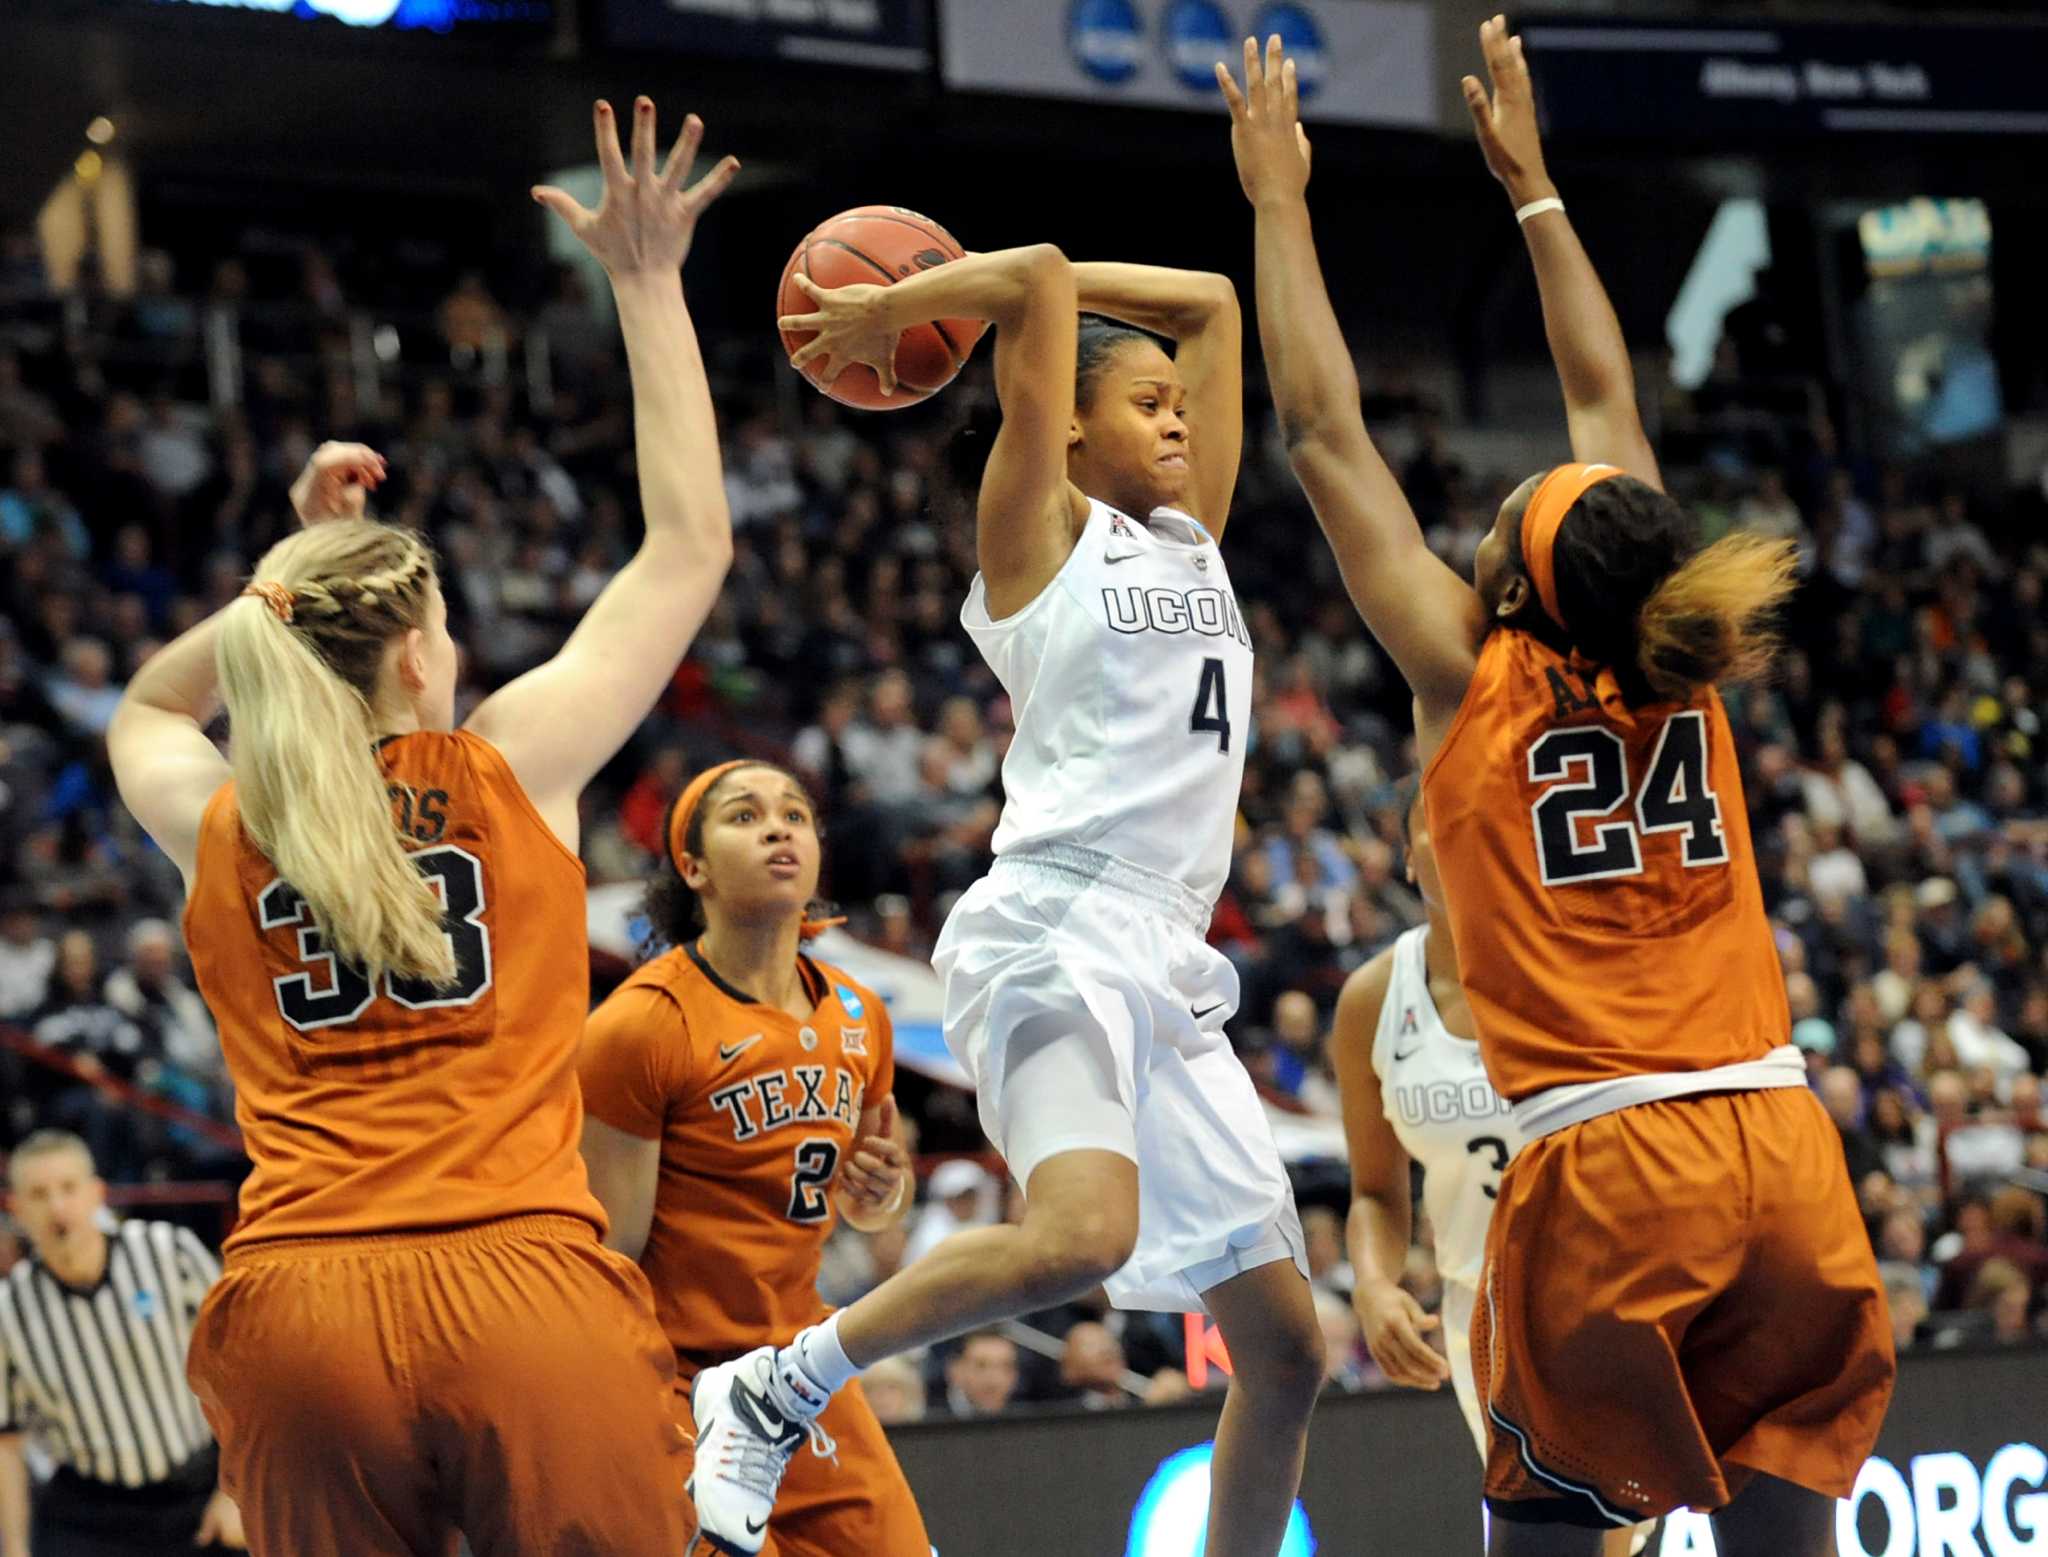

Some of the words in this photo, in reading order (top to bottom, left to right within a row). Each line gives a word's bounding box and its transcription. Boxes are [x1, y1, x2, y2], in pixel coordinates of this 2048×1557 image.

[1102, 586, 1254, 652] UCON
[1189, 656, 1231, 756] 4
[1527, 710, 1730, 886] 24
[709, 1065, 866, 1141] TEXA
[787, 1137, 840, 1223] 2
